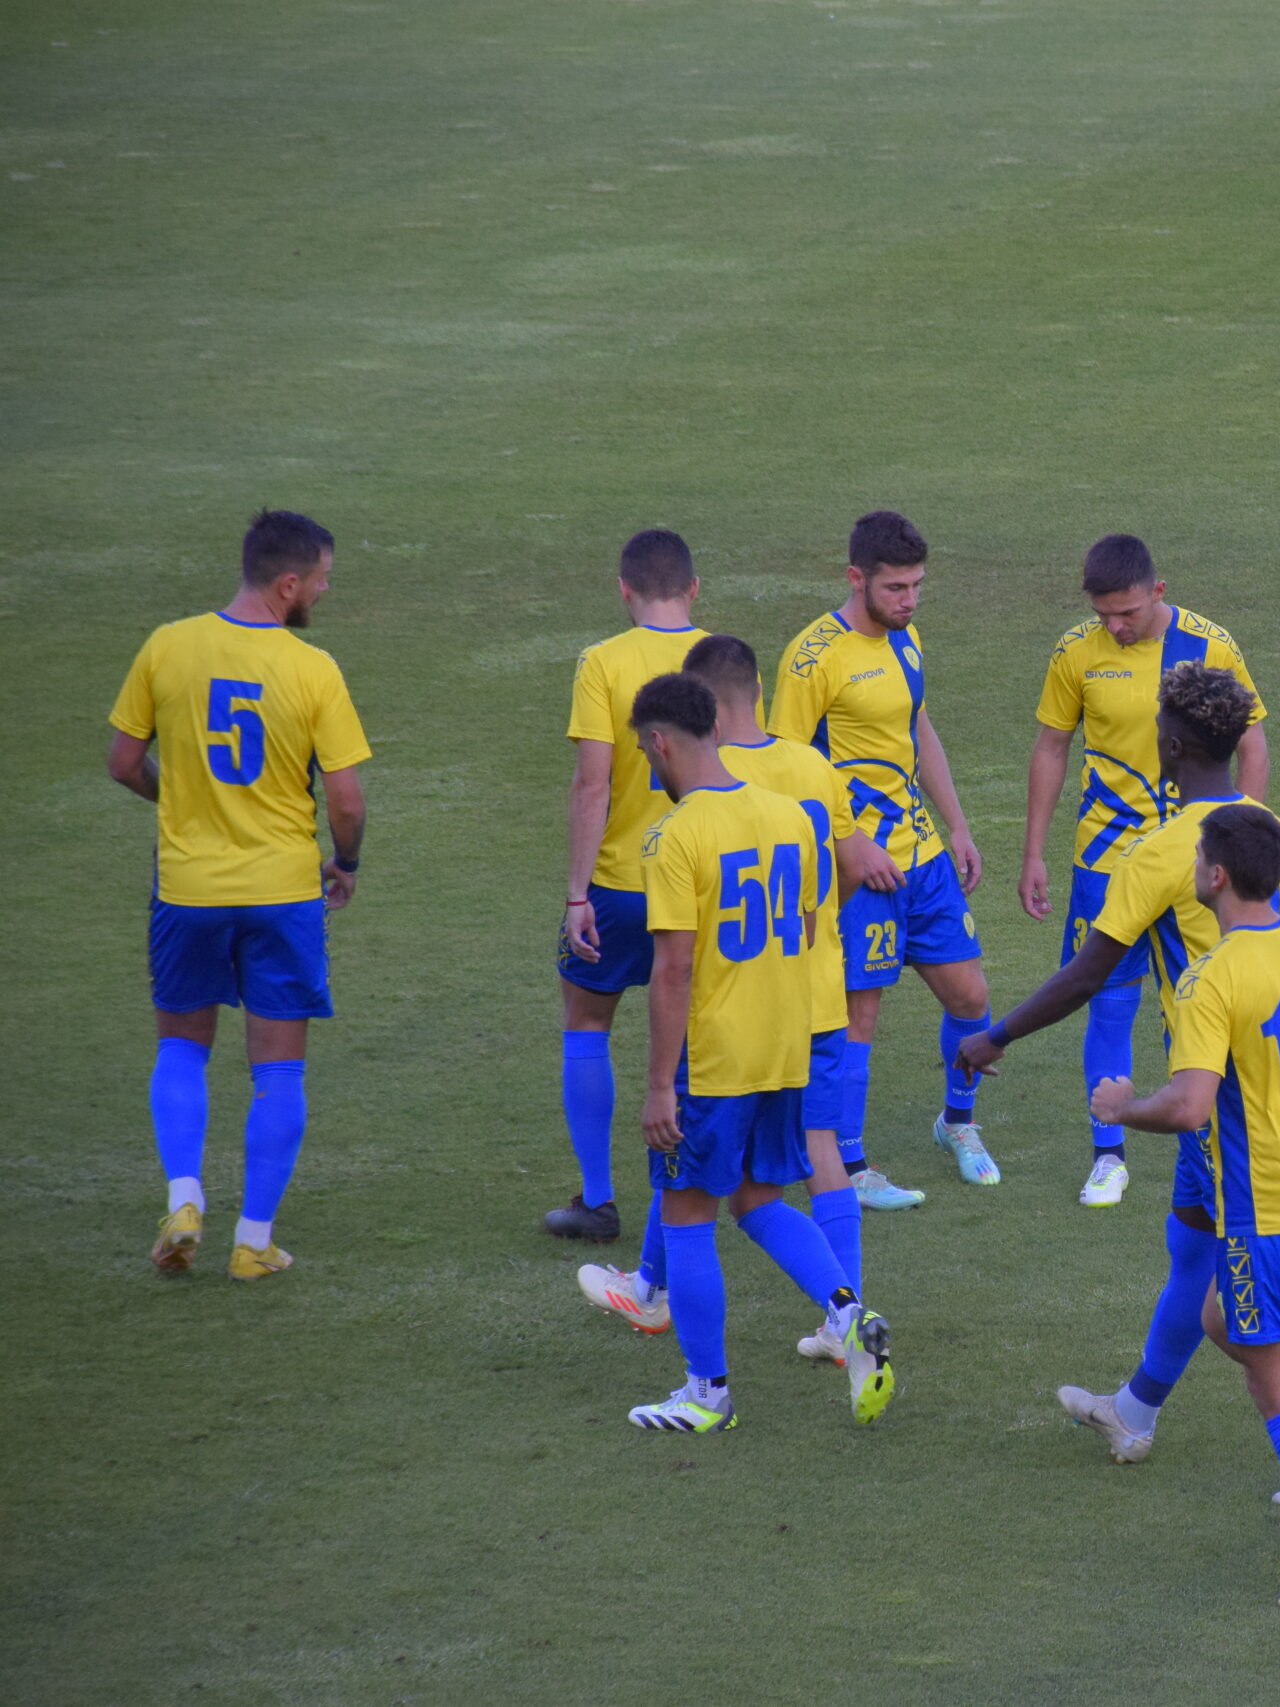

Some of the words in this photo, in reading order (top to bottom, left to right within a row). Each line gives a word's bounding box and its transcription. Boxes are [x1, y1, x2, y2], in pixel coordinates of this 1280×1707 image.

[850, 667, 885, 682] GIVOVA
[1085, 670, 1133, 679] GIVOVA
[207, 678, 264, 787] 5
[717, 843, 803, 963] 54
[865, 920, 896, 961] 23
[864, 958, 899, 972] GIVOVA
